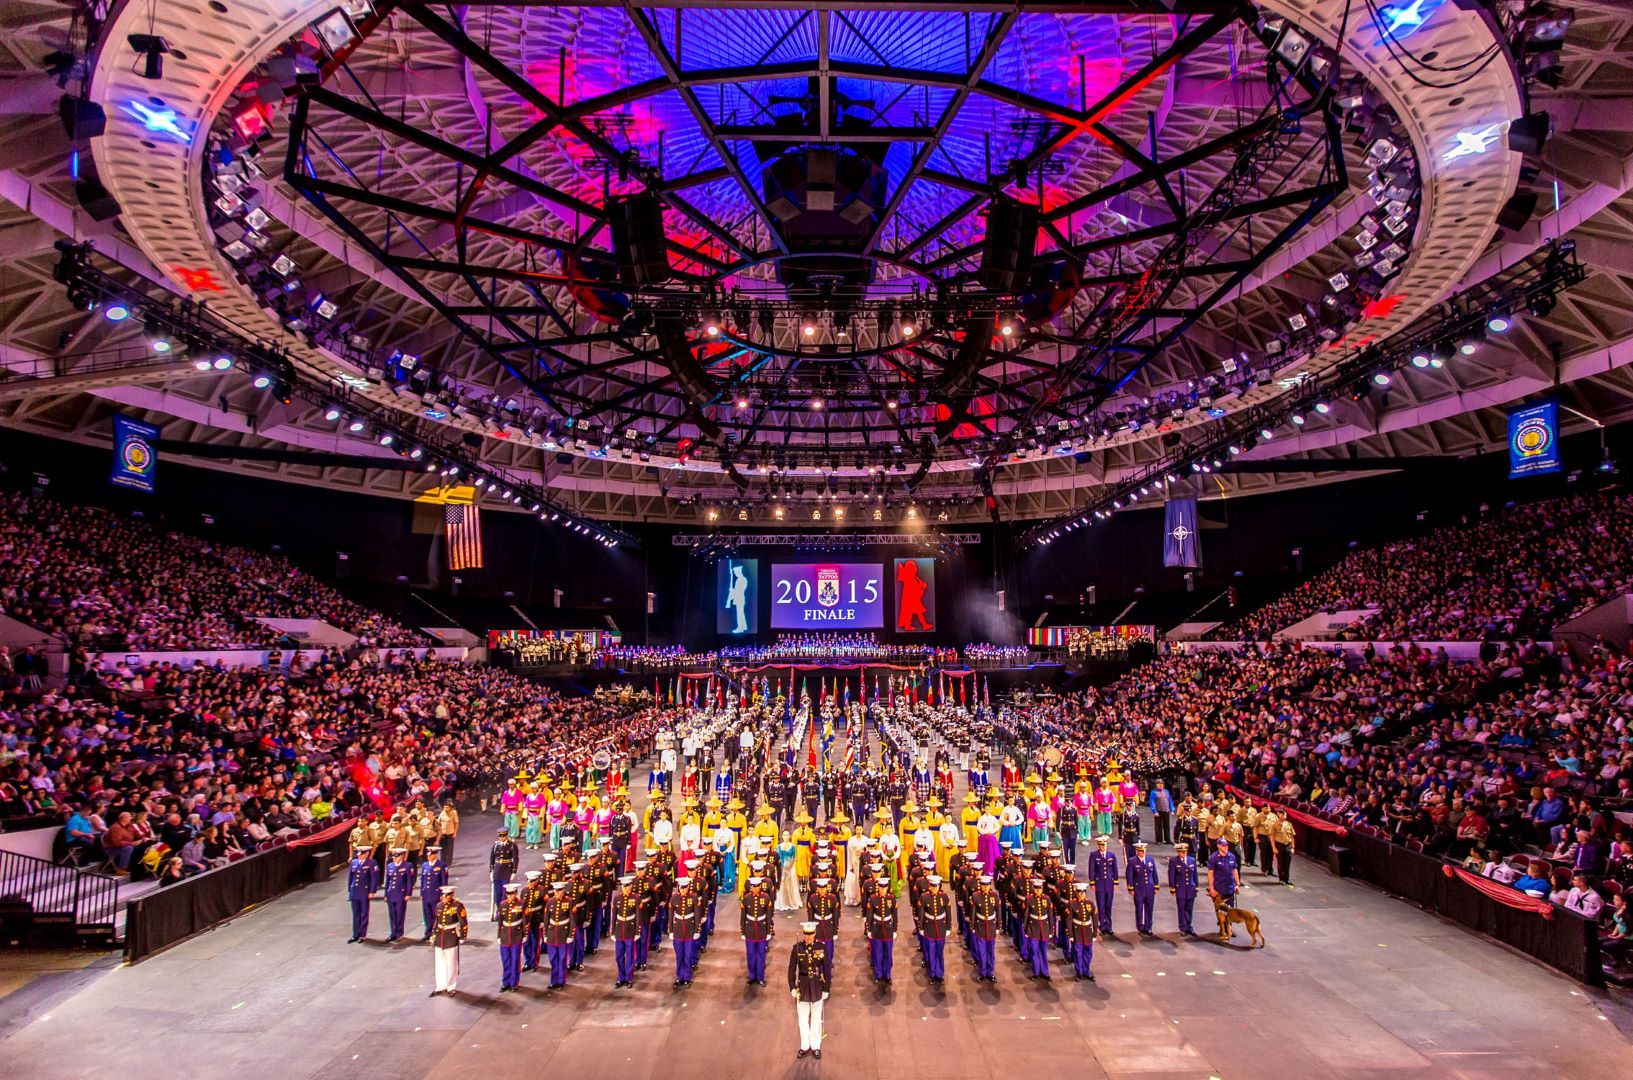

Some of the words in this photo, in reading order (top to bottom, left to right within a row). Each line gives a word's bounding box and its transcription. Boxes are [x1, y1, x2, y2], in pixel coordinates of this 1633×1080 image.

[776, 579, 811, 603] 20
[848, 579, 878, 603] 15
[803, 609, 855, 620] FINALE
